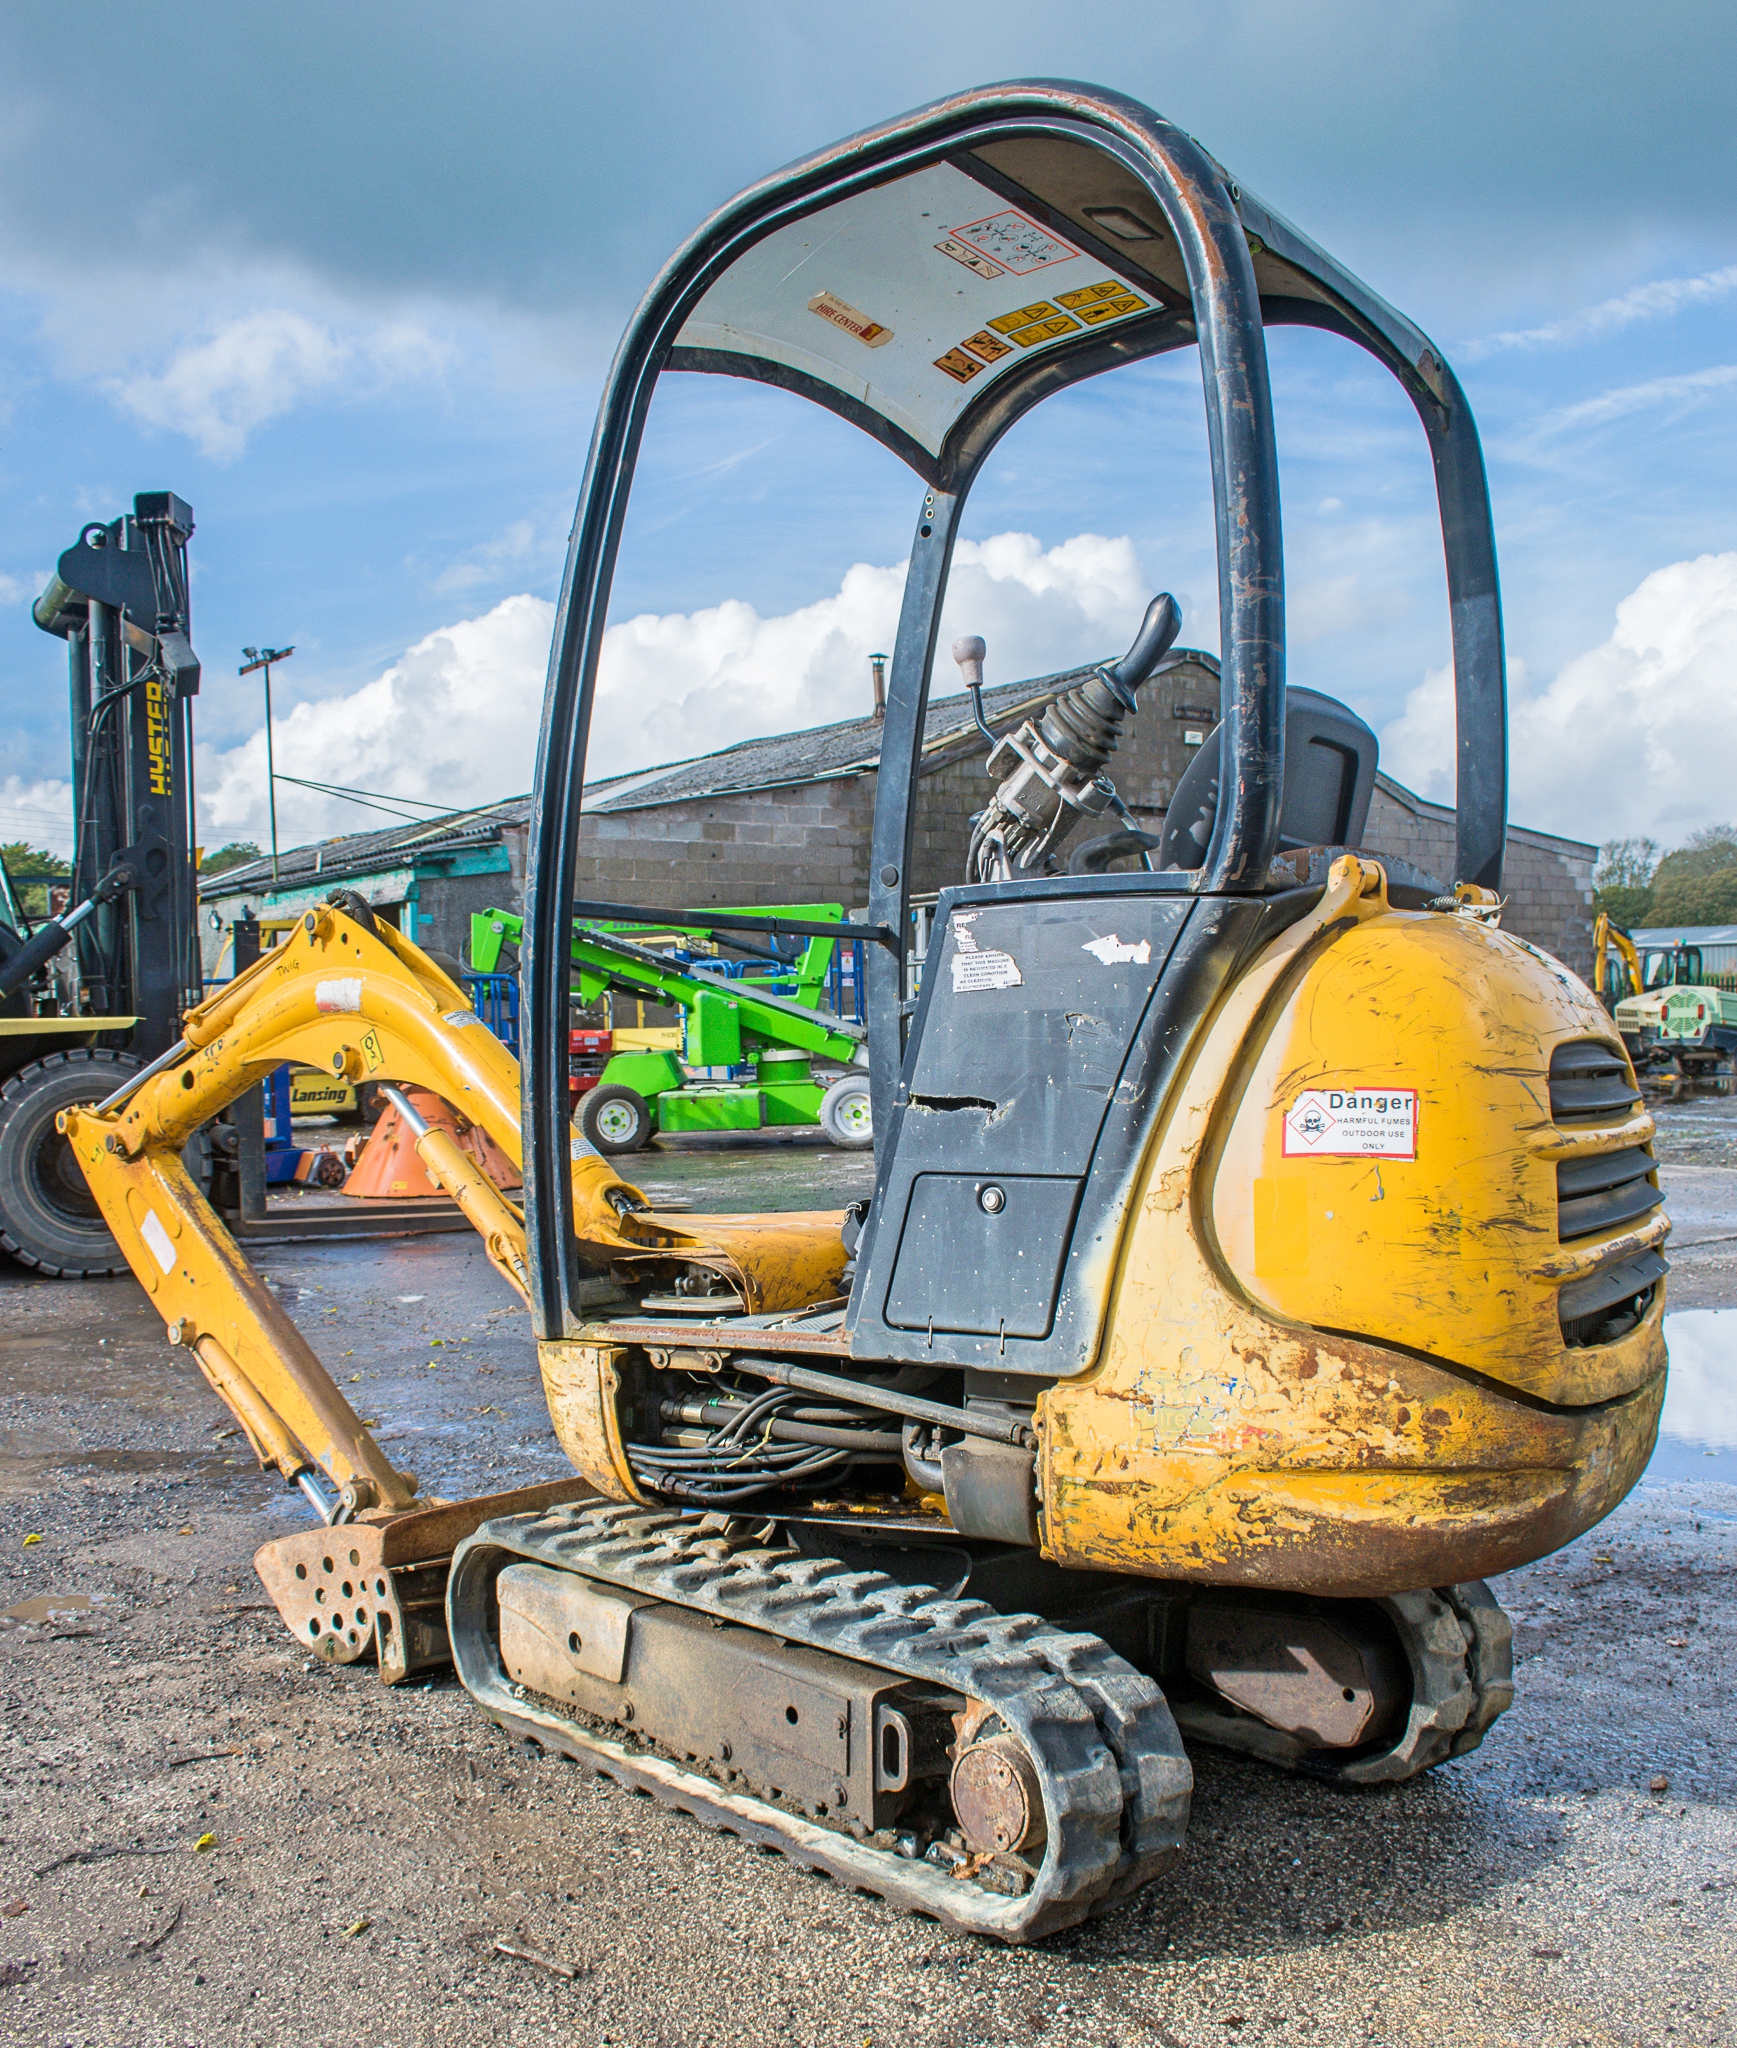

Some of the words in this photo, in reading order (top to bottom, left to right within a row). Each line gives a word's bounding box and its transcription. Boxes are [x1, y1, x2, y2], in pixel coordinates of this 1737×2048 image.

[816, 303, 838, 318] HIRE
[833, 313, 863, 334] CENTER
[291, 1086, 348, 1104] Lansing
[1329, 1093, 1413, 1113] Danger
[1337, 1117, 1379, 1125] HARMFUL
[1361, 1142, 1385, 1150] ONLY
